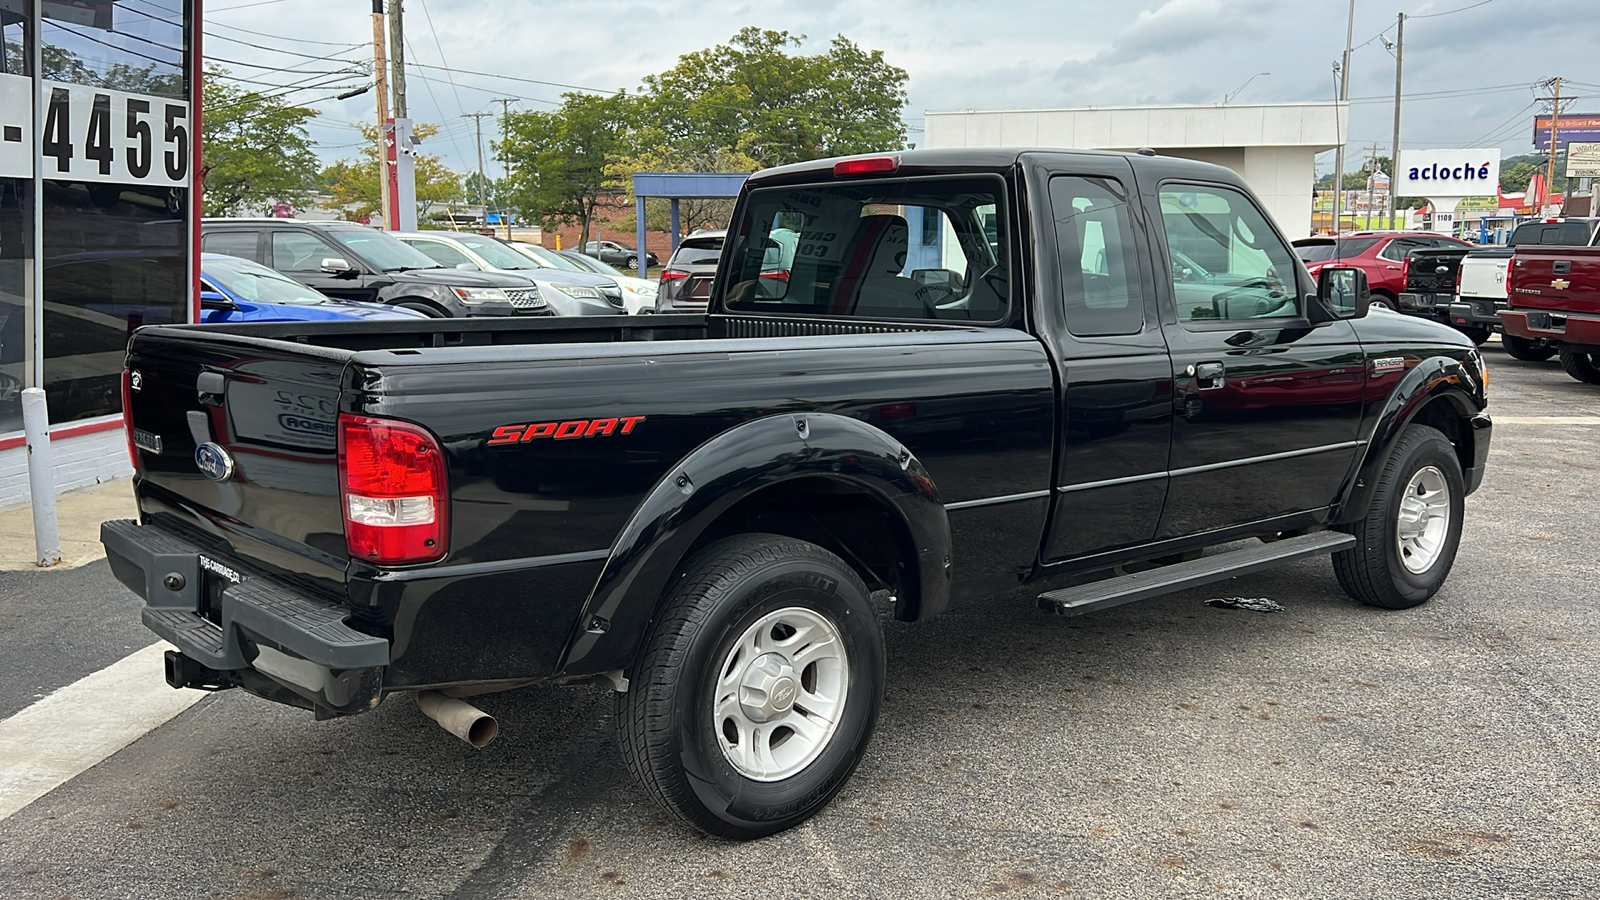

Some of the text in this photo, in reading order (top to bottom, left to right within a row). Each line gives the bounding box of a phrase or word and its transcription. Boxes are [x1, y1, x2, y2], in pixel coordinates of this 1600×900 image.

[1408, 161, 1490, 180] acloché
[1376, 357, 1404, 367] RANGER
[486, 415, 646, 446] SPORT
[198, 448, 218, 474] Ford
